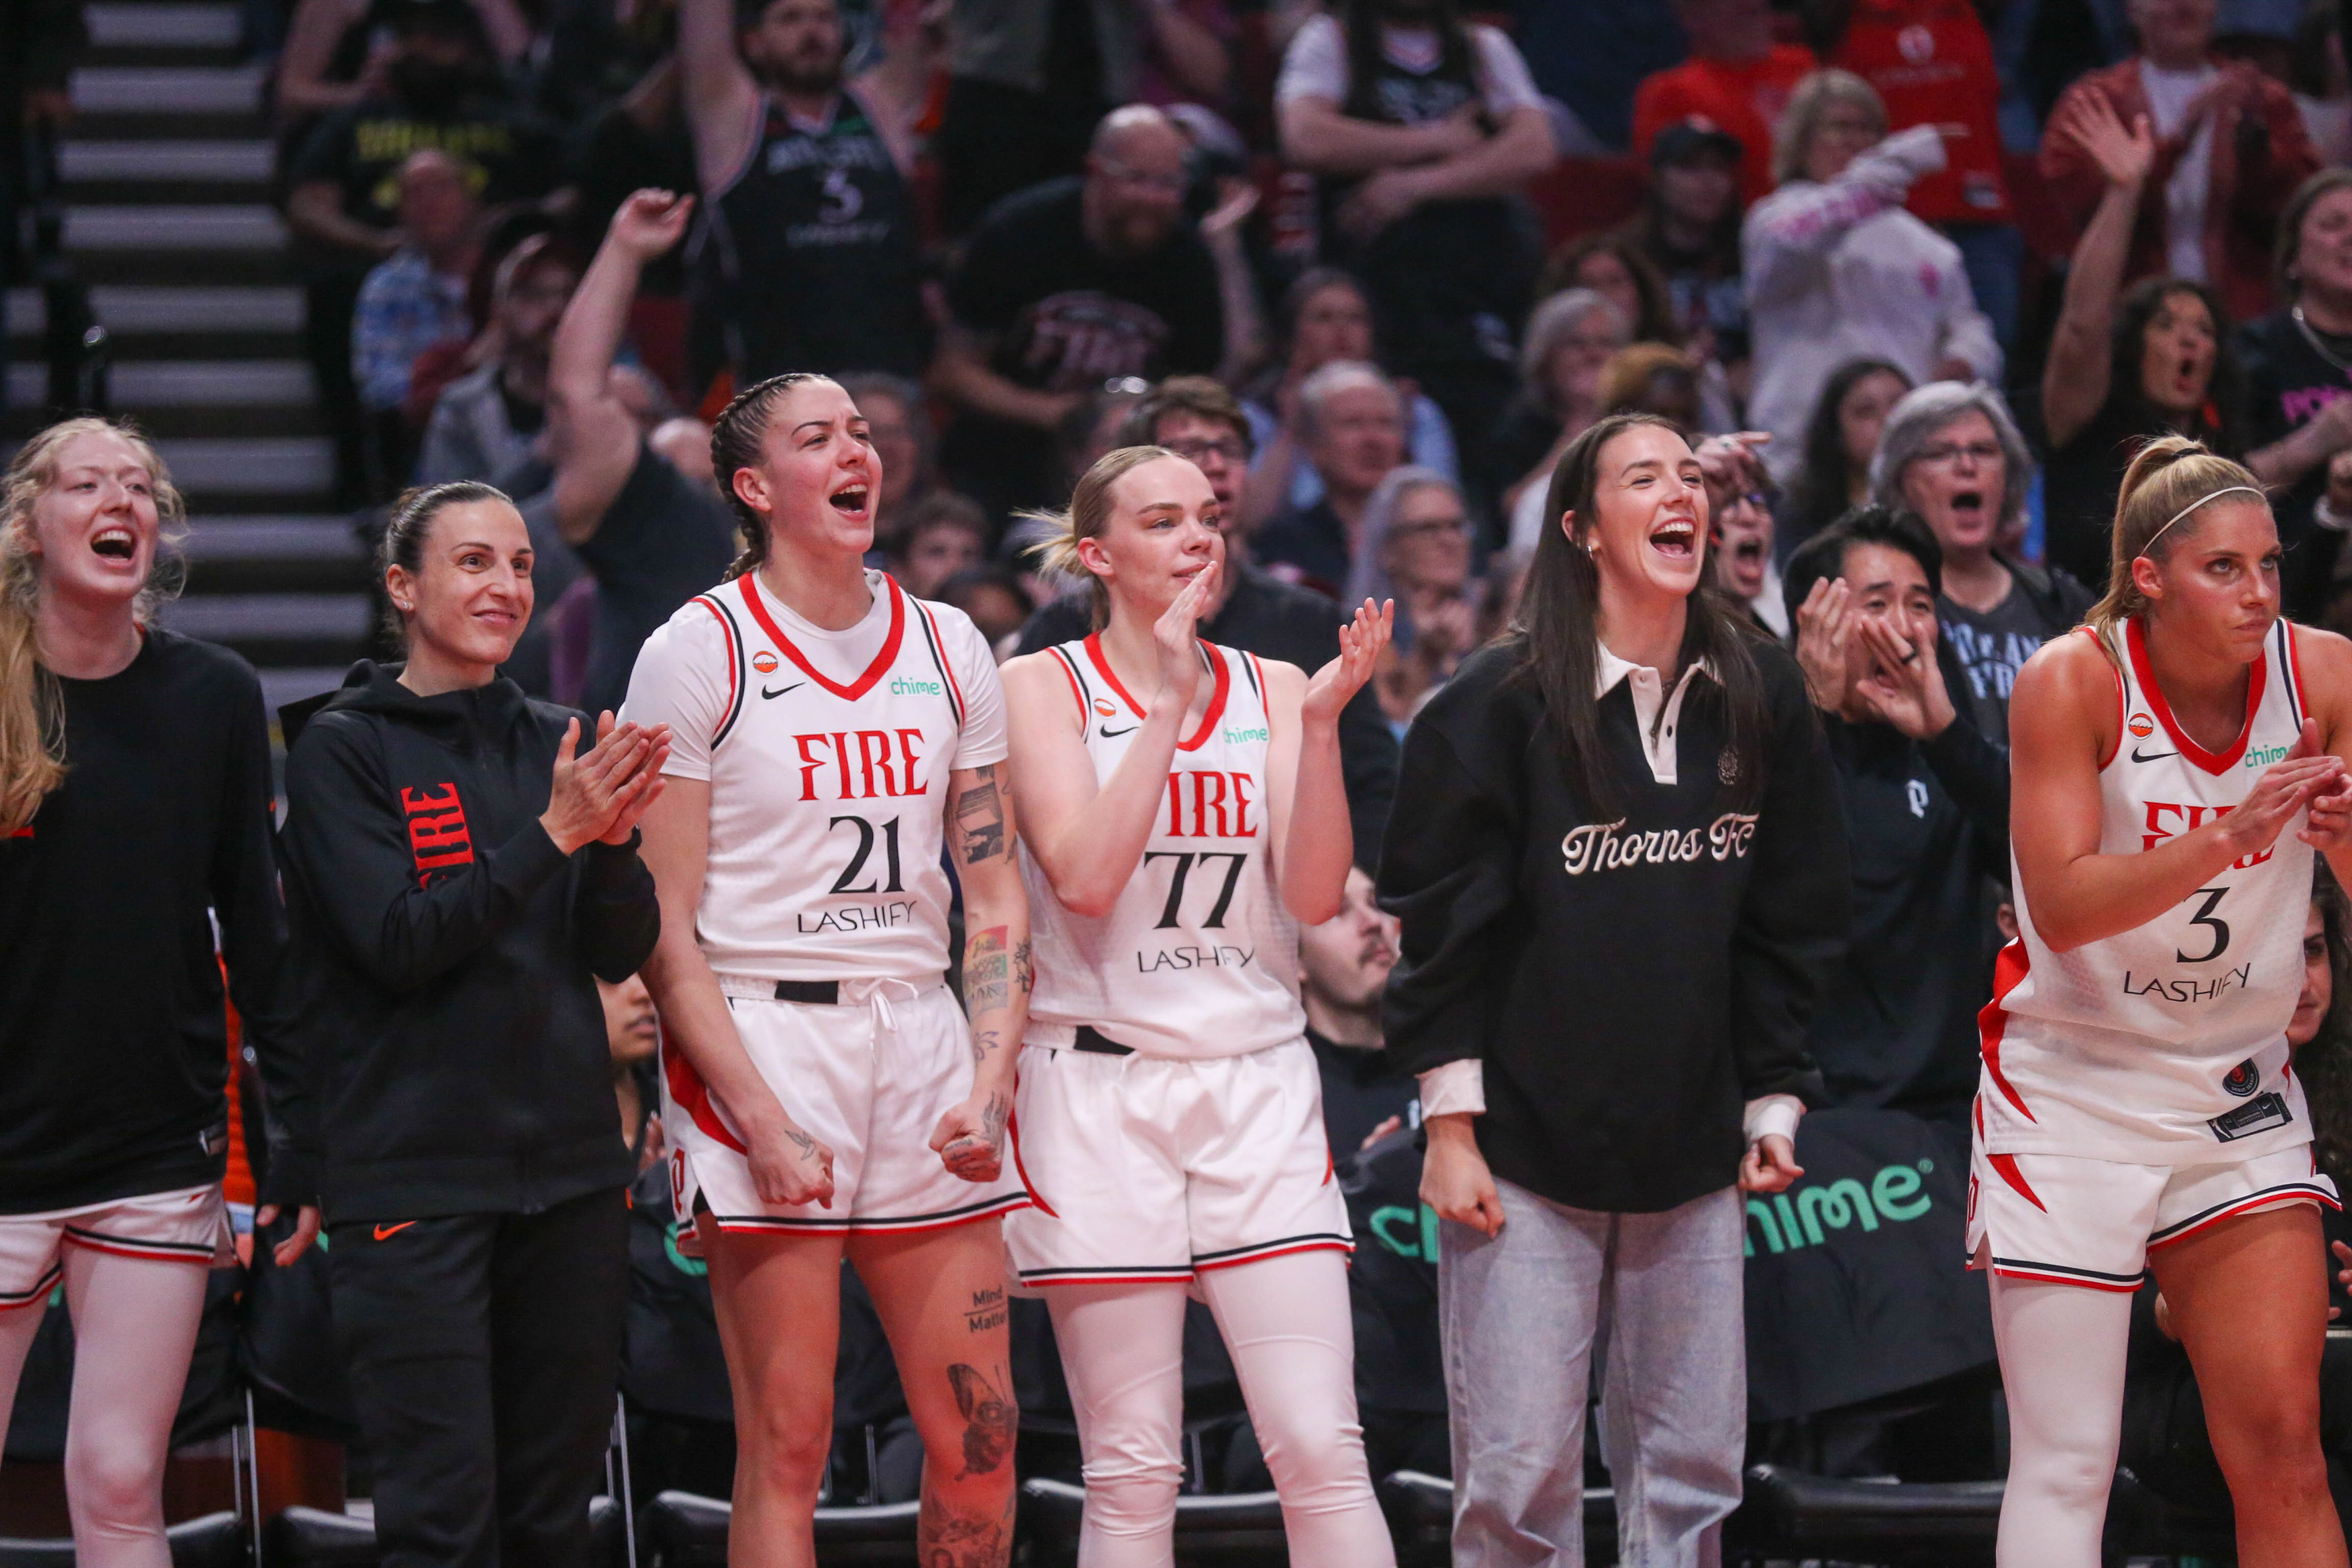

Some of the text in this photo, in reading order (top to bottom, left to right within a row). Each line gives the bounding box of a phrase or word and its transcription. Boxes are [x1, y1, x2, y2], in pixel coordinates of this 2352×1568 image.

[891, 676, 940, 696] chime
[791, 728, 928, 801] FIRE
[1164, 771, 1258, 838] IRE
[828, 815, 905, 894] 21
[1561, 817, 1703, 876] Thorns
[797, 901, 917, 933] LASHIFY
[1144, 851, 1247, 929] 77
[2176, 887, 2231, 963] 3
[2124, 962, 2250, 1002] LASHIFY
